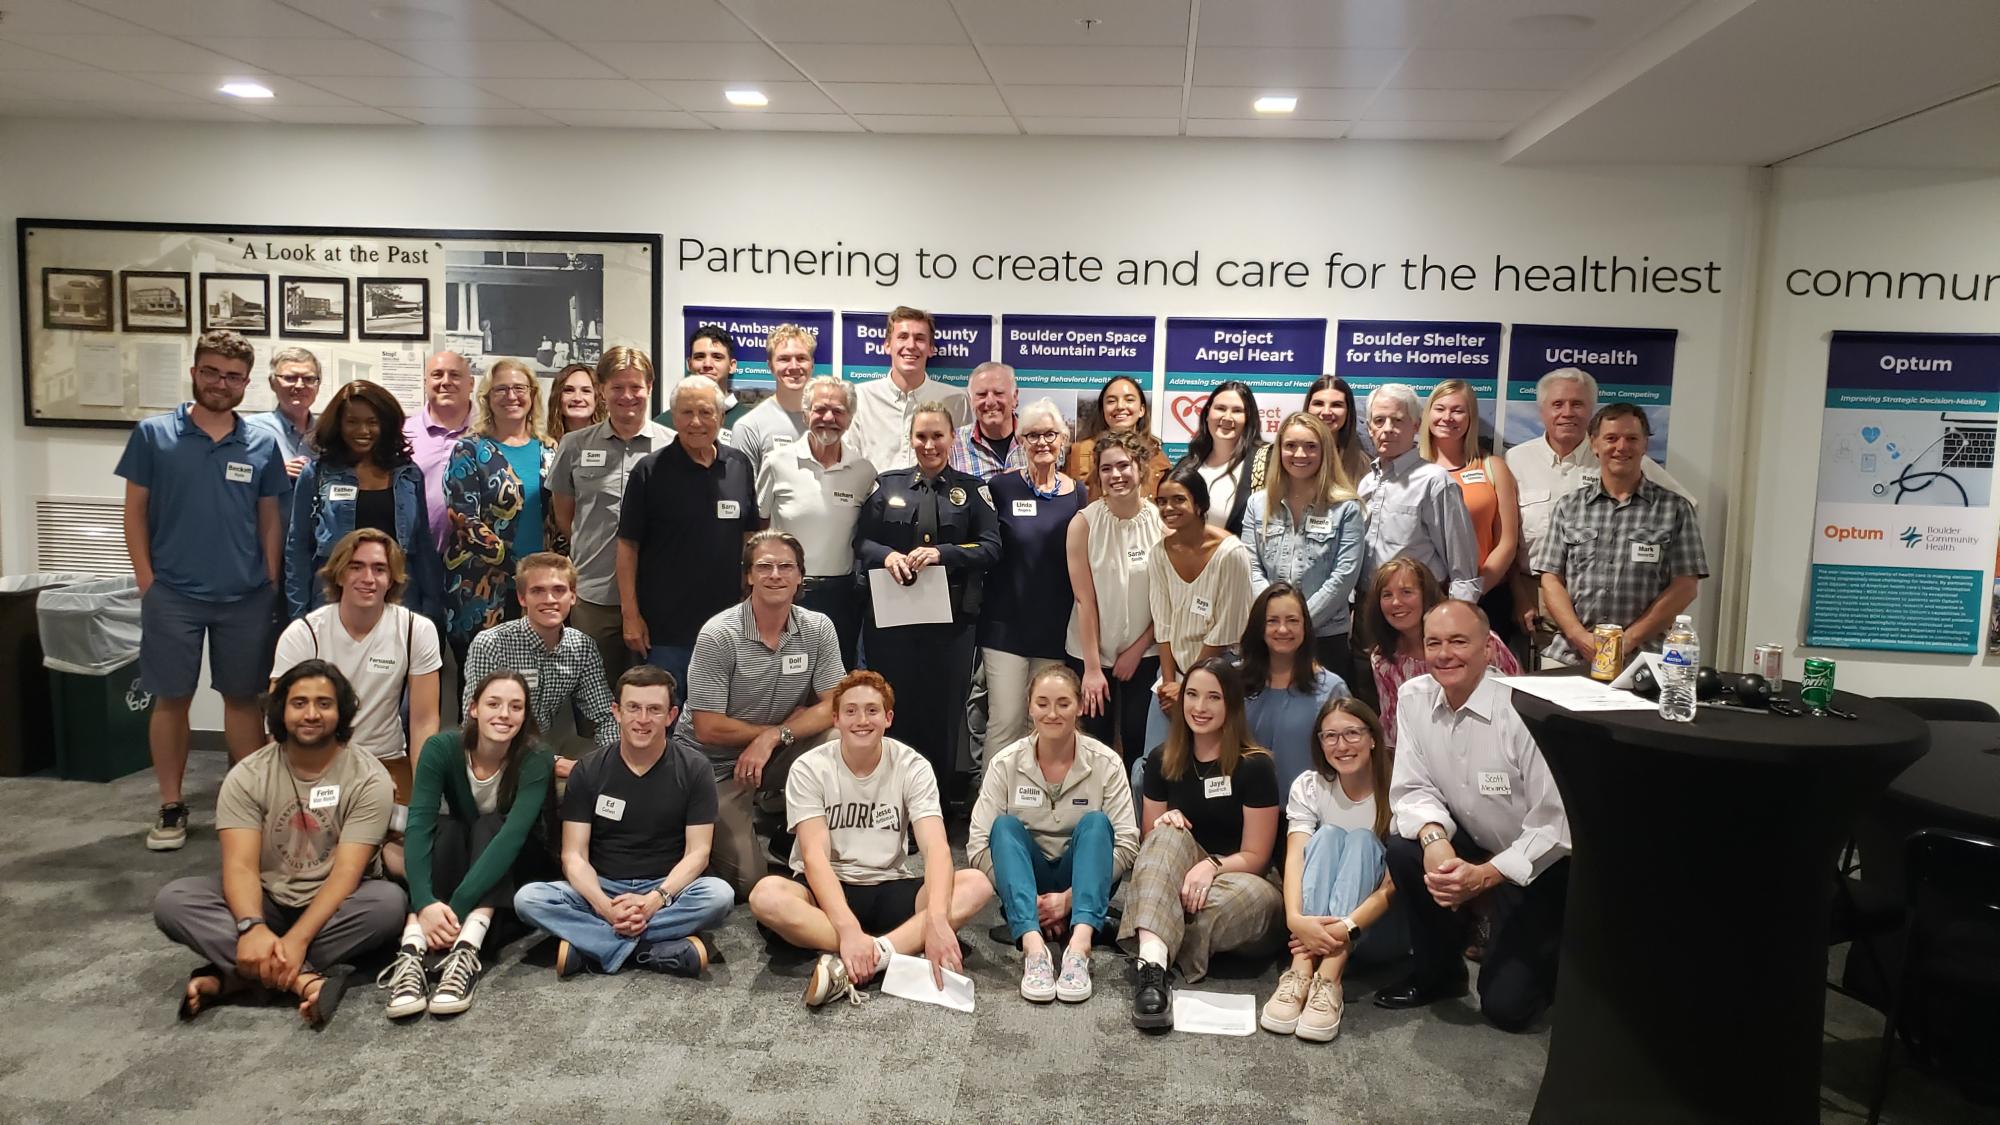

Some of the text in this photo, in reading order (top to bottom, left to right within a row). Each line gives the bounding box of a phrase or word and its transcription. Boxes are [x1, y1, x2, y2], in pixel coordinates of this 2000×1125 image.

[242, 243, 429, 264] A Look at the Past
[680, 238, 899, 287] Partnering
[915, 248, 956, 279] to
[972, 251, 1102, 282] create
[1116, 250, 1199, 287] and
[1216, 260, 1309, 288] care
[1325, 252, 1385, 290] for
[1401, 254, 1476, 291] the
[1494, 255, 1722, 293] healthiest
[1010, 330, 1147, 345] Boulder Open Space
[1214, 331, 1273, 347] Project
[1352, 332, 1486, 347] Boulder Shelter
[1019, 344, 1137, 357] & Mountain Parks
[1195, 347, 1294, 364] Angel Heart
[1346, 349, 1489, 364] for the Homeless
[1545, 349, 1638, 365] UCHealth
[1880, 355, 1952, 374] Optum
[1050, 376, 1088, 384] Behavioral
[1168, 378, 1210, 386] Addressing
[1618, 391, 1660, 399] Competing
[1840, 395, 1987, 407] Improving Strategic Decision-Making
[721, 503, 737, 511] Barry
[1016, 501, 1033, 509] Linda
[1824, 525, 1884, 542] Optum
[1927, 526, 1961, 534] Boulder
[1926, 534, 1980, 545] Community
[1638, 545, 1654, 553] Mark
[1926, 543, 1955, 551] Health
[1127, 550, 1146, 560] Sarah
[1484, 774, 1503, 784] Scott
[606, 800, 615, 808] Ed
[876, 808, 892, 818] Jesse
